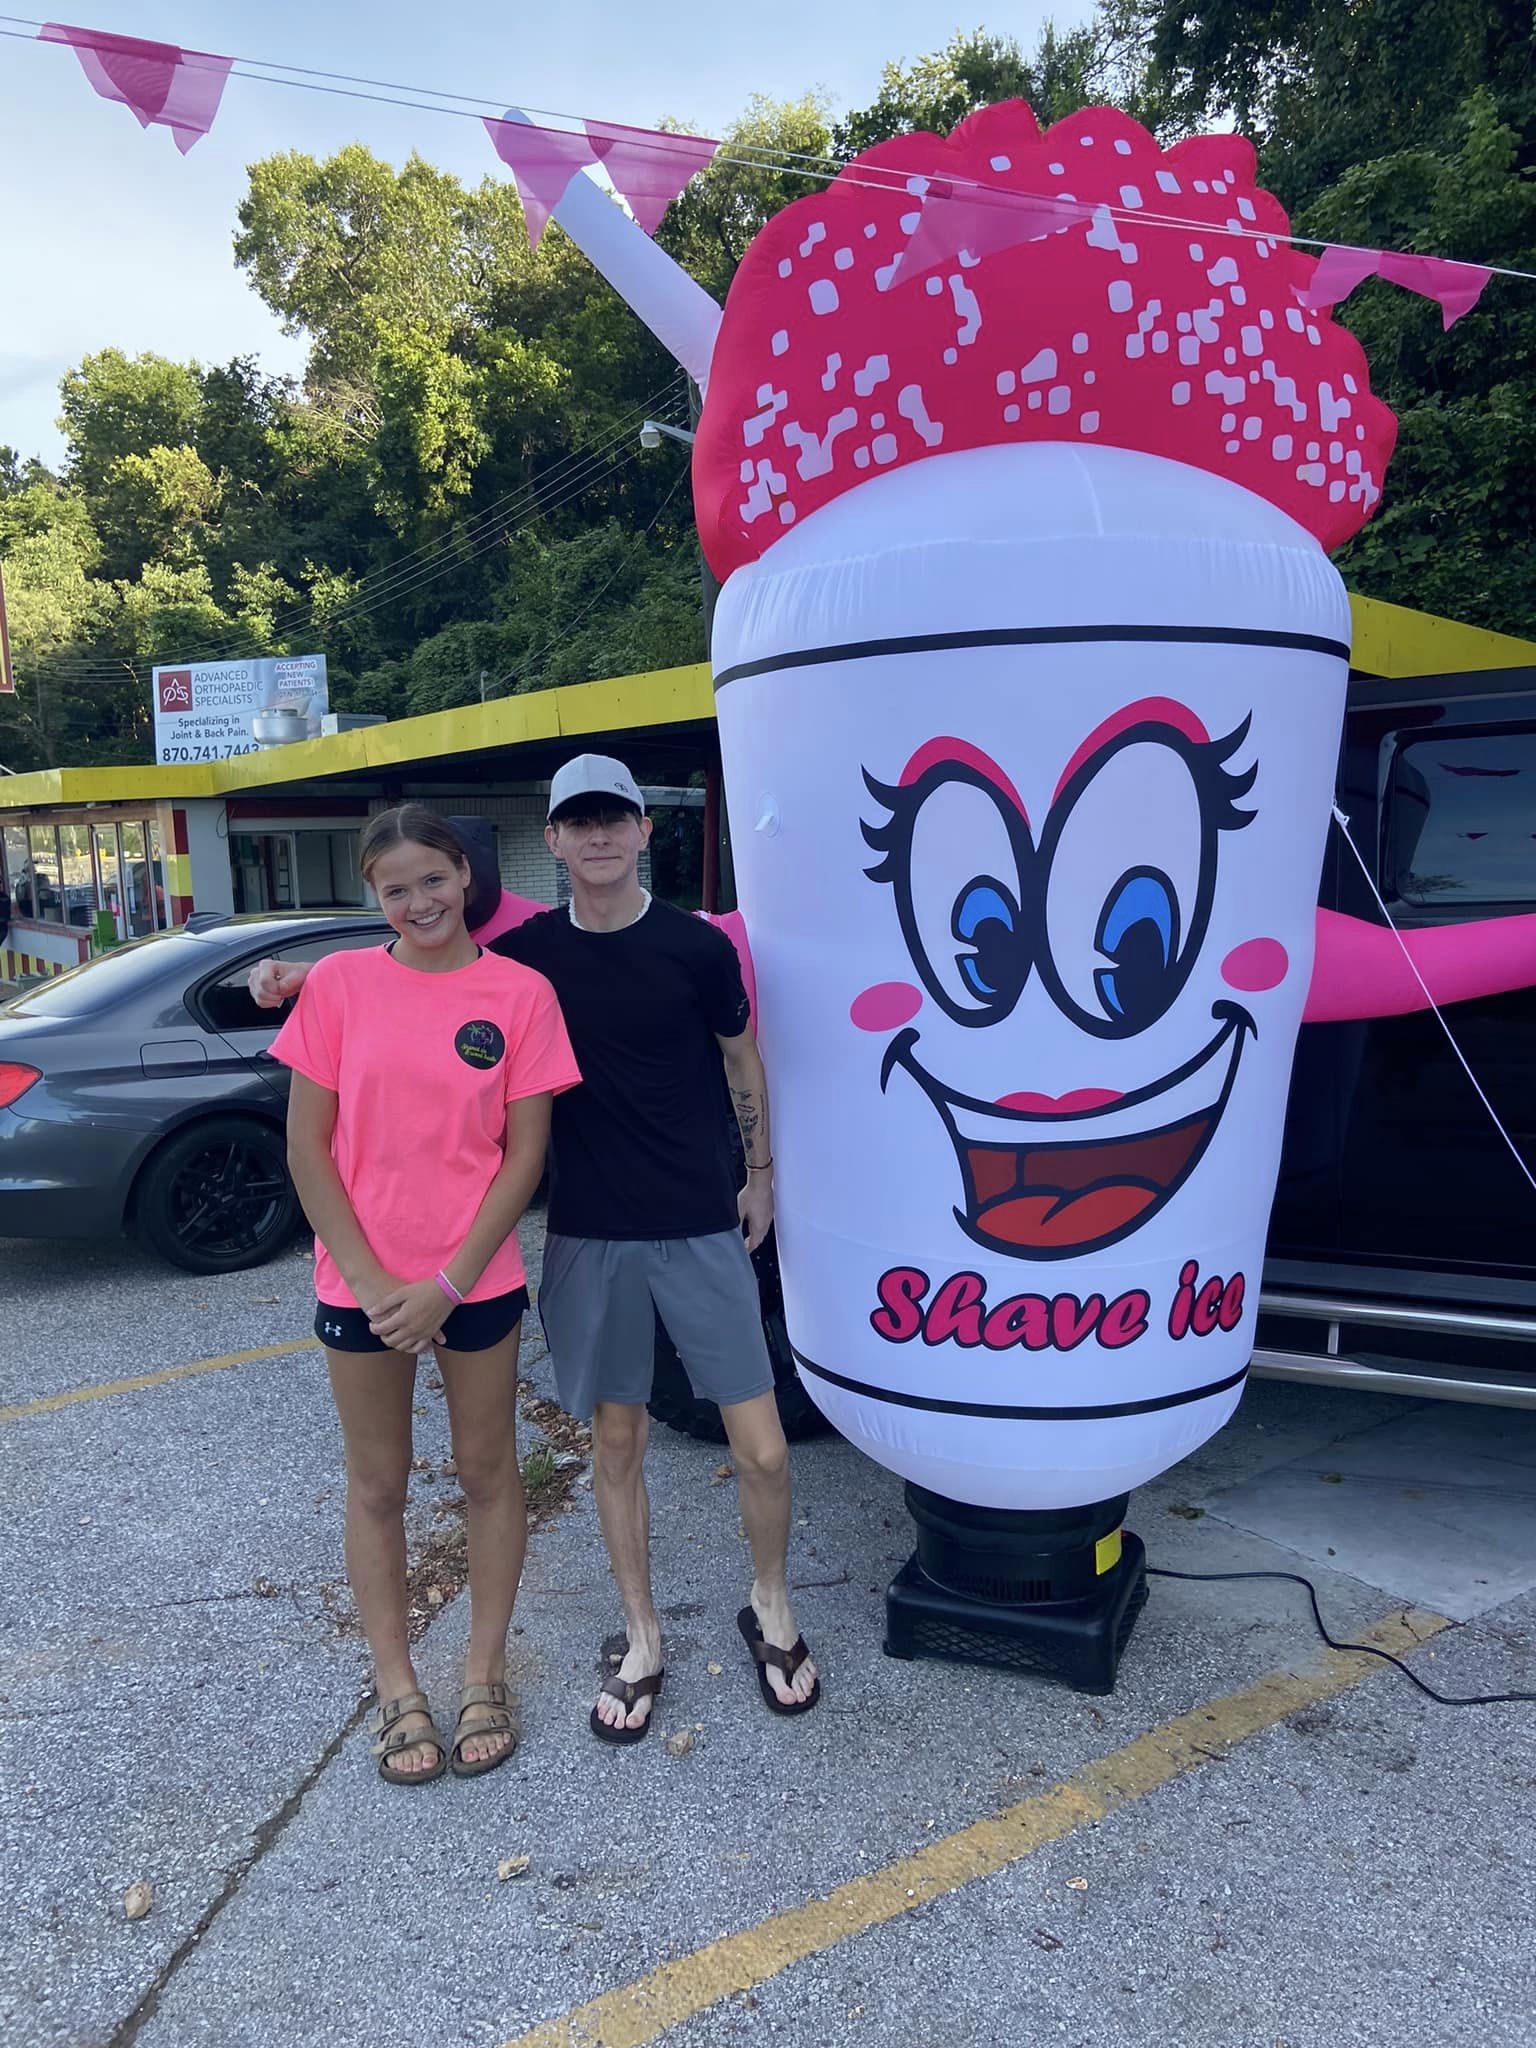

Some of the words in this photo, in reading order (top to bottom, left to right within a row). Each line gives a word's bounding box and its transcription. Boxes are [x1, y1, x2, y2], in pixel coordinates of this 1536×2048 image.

[276, 661, 316, 671] ACCEPTING
[194, 670, 248, 682] ADVANCED
[287, 671, 304, 679] NEW
[194, 681, 264, 695] ORTHOPAEDIC
[195, 694, 253, 707] SPECIALISTS
[178, 716, 229, 729] Specializing
[231, 715, 240, 725] in
[170, 730, 192, 740] Joint
[194, 729, 202, 738] &
[204, 728, 225, 738] Back
[870, 1266, 1151, 1352] Shave
[1167, 1258, 1246, 1341] ice
